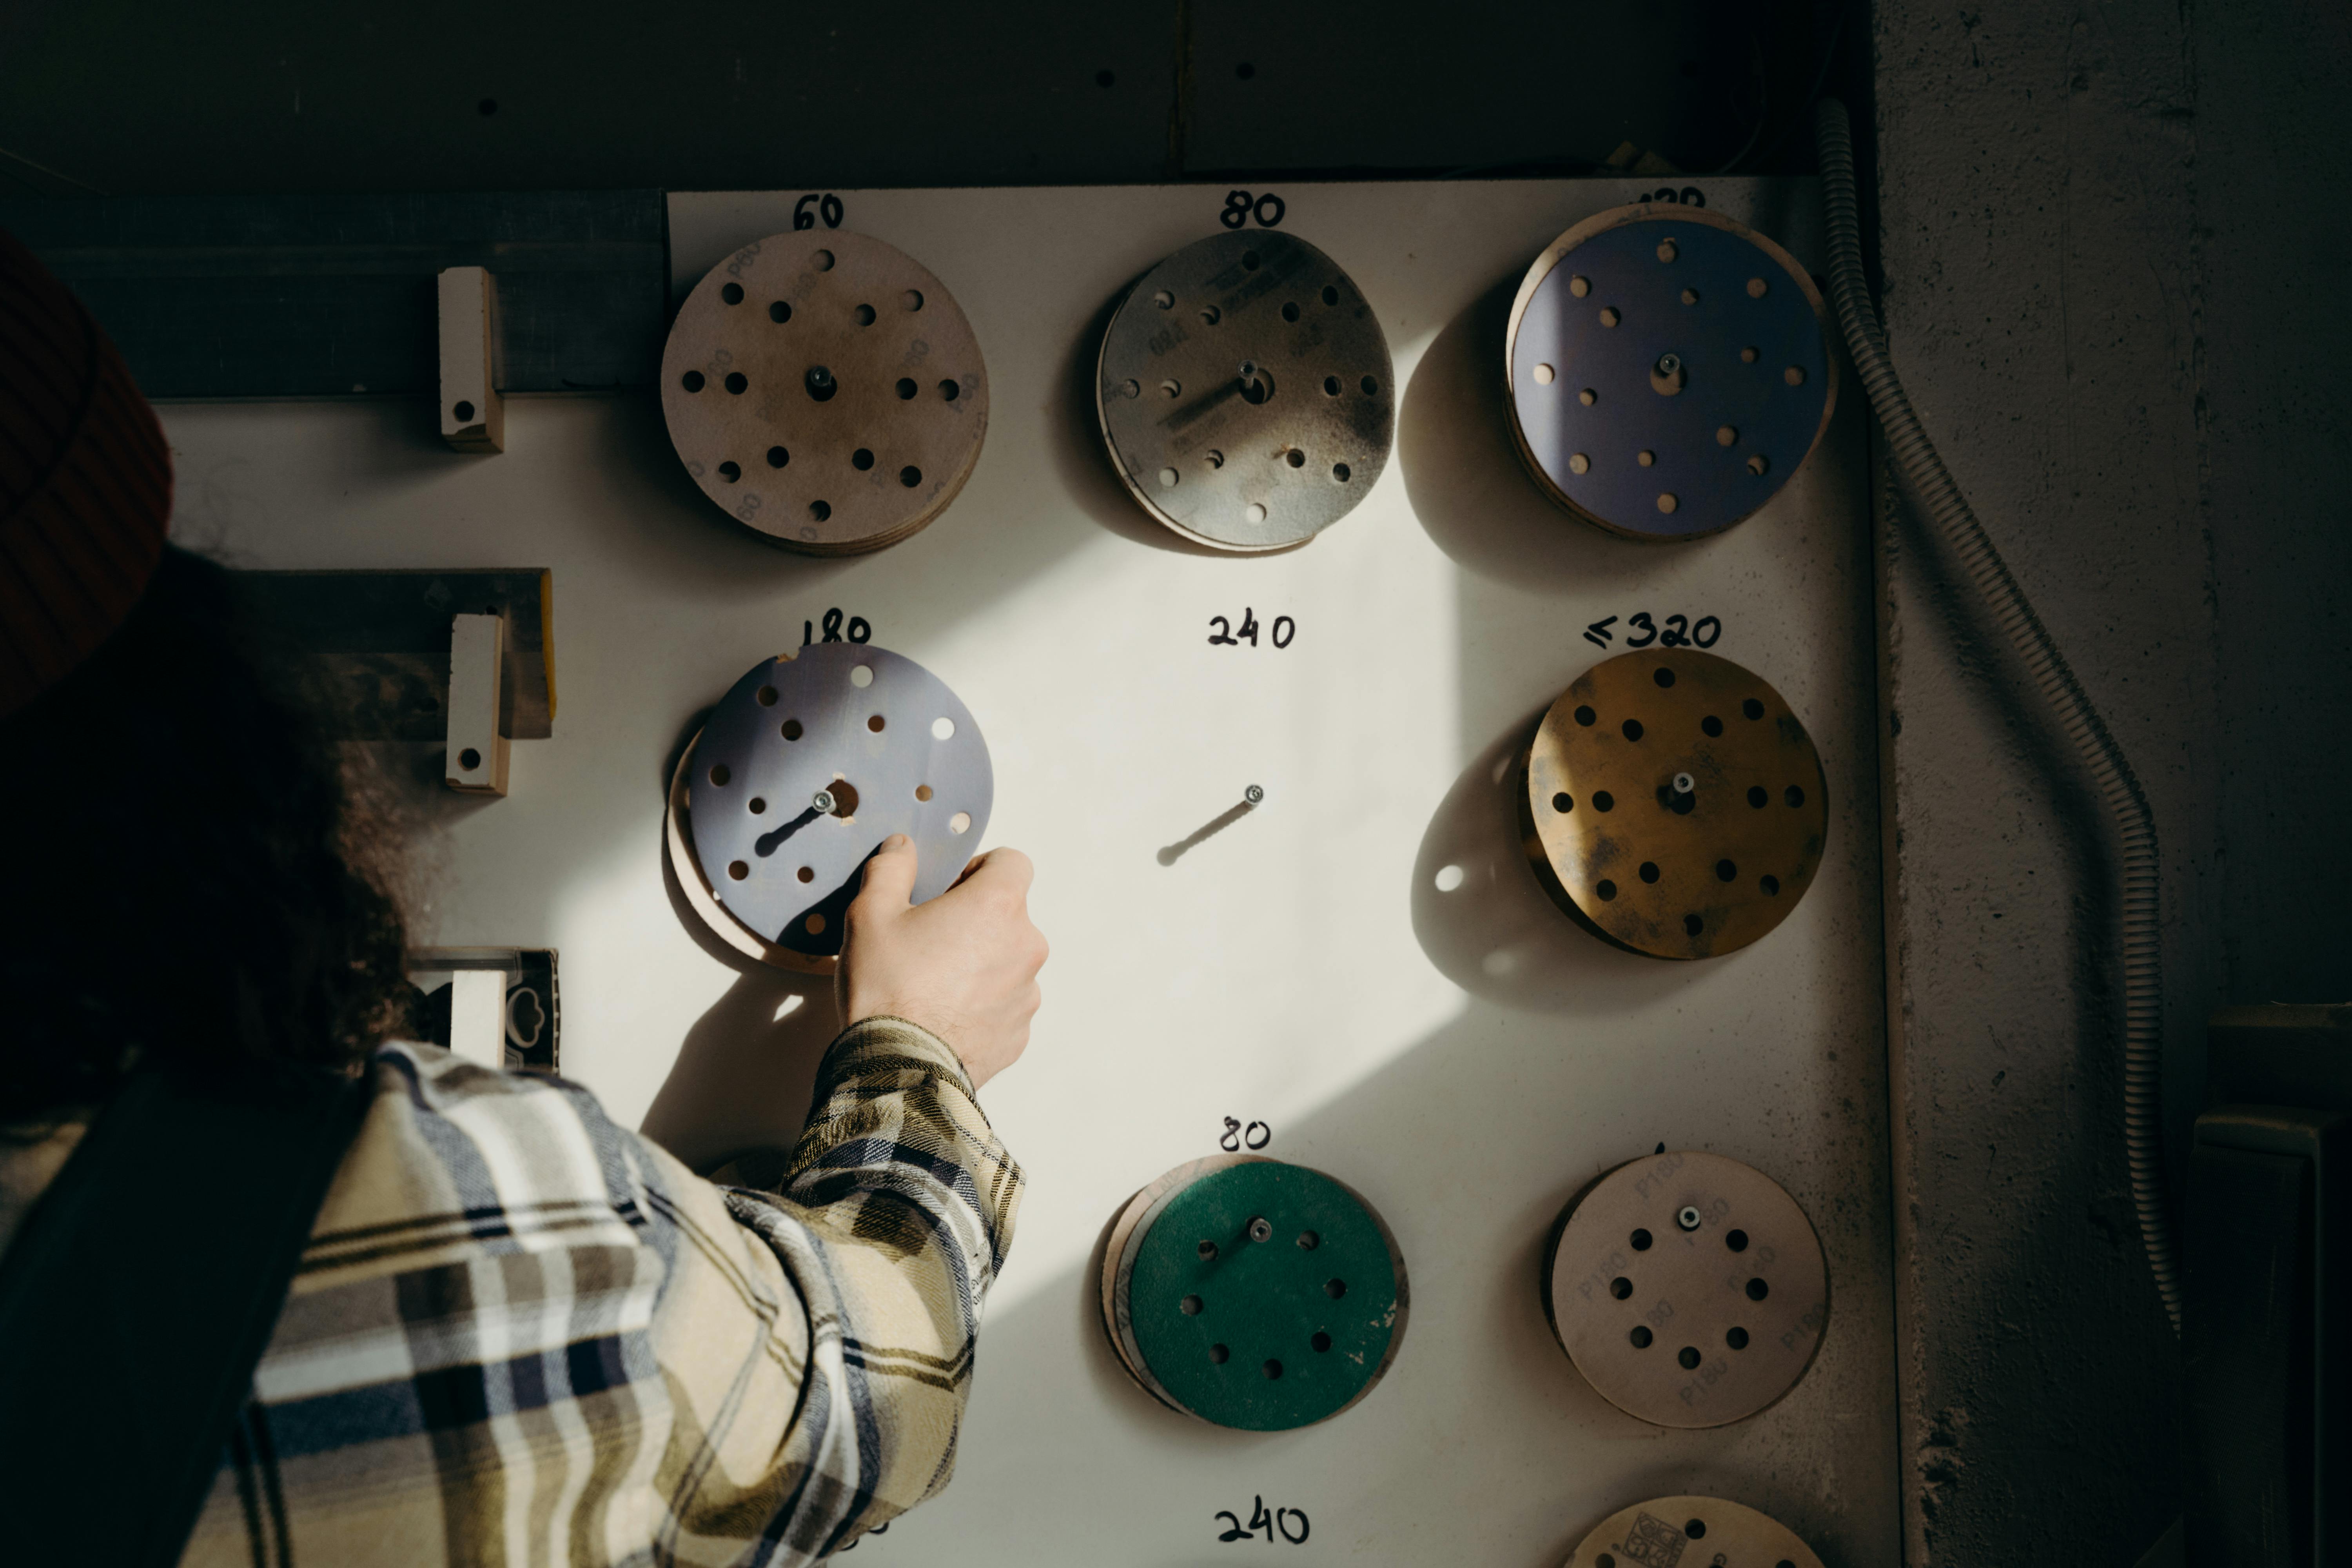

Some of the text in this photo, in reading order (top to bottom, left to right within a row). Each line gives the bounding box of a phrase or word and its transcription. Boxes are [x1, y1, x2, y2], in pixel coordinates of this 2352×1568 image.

[793, 193, 844, 231] 60
[1220, 190, 1286, 229] 80
[1638, 186, 1706, 208] 20
[803, 607, 871, 646] 180
[1208, 607, 1295, 649] 240
[1220, 1116, 1271, 1152] 80
[1215, 1495, 1310, 1545] 240
